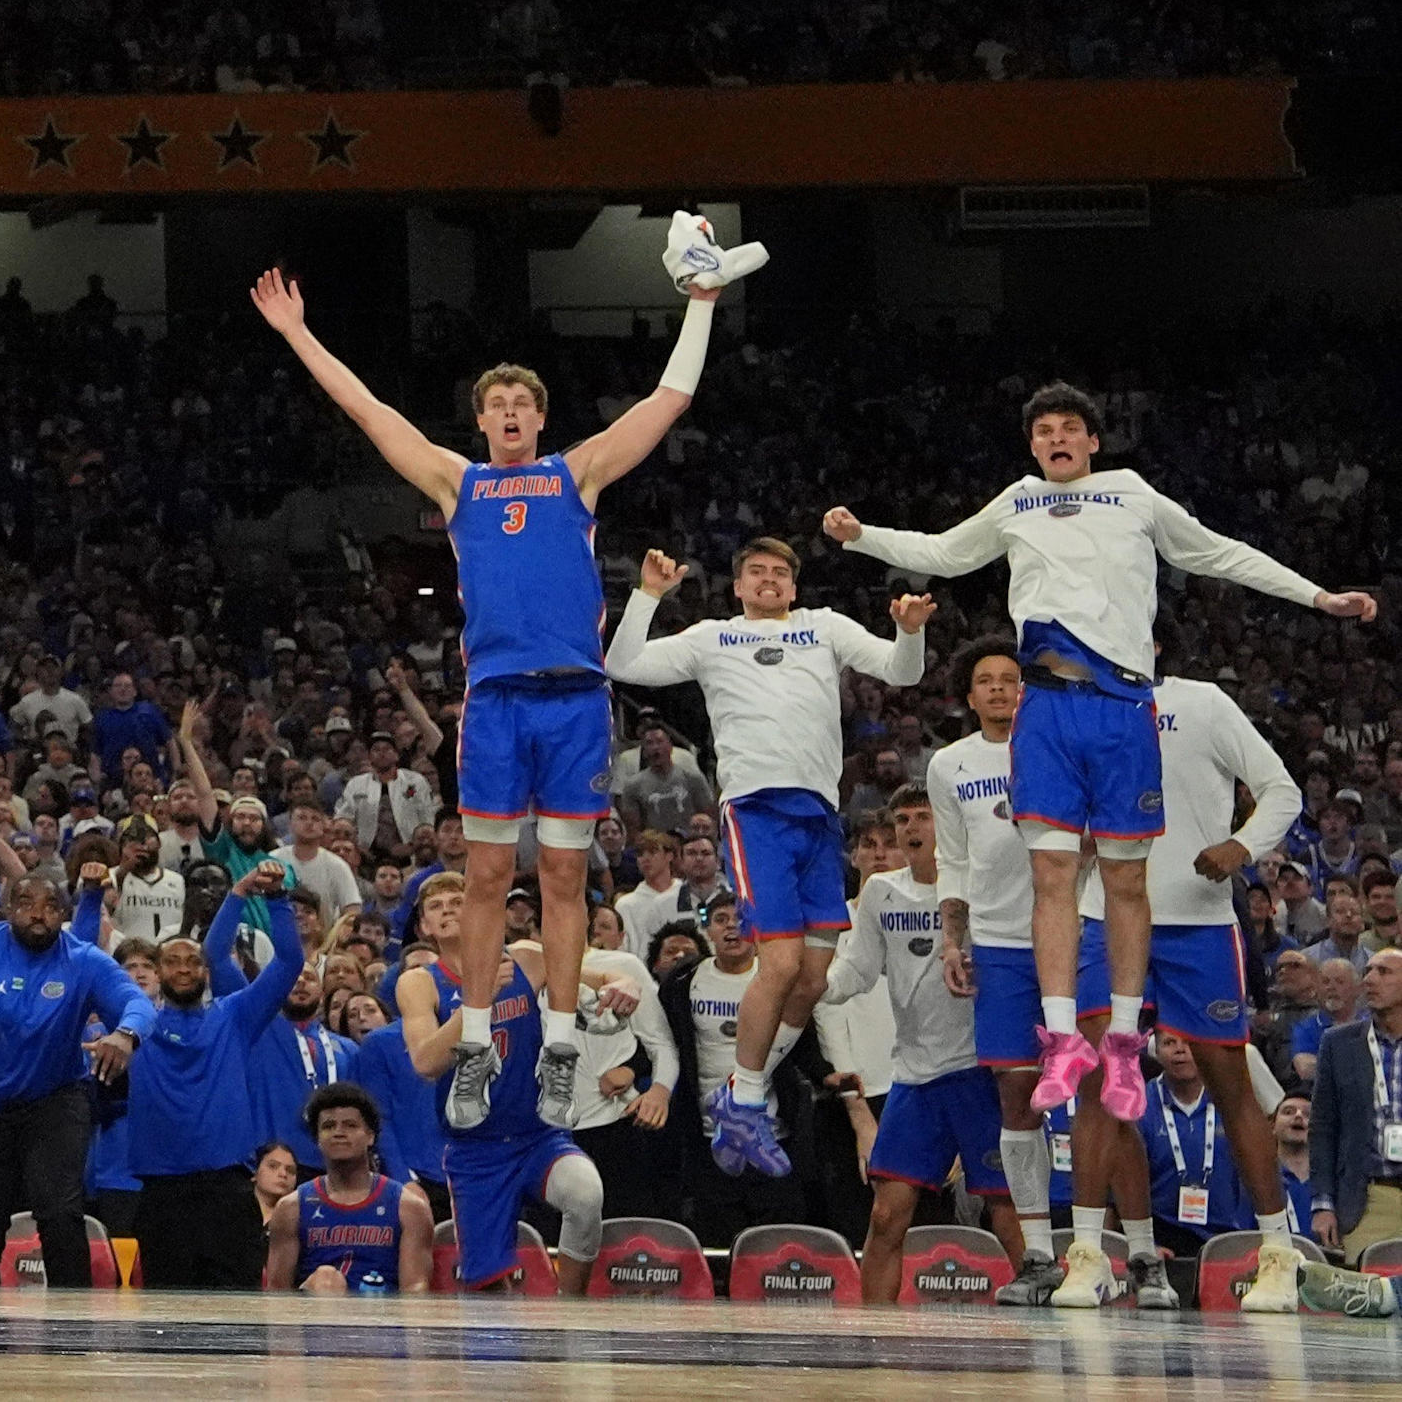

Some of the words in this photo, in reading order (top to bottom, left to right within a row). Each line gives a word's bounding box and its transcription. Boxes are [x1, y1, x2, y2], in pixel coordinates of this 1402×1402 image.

[471, 475, 562, 501] FLORIDA
[501, 501, 528, 535] 3
[1158, 714, 1178, 732] SY.
[956, 776, 1010, 803] NOTHIN
[880, 911, 931, 932] NOTHING
[307, 1225, 394, 1247] FLORIDA
[18, 1259, 45, 1272] FINA
[610, 1266, 644, 1282] FINAL
[645, 1267, 678, 1282] FOUR
[765, 1275, 798, 1290] FINAL
[799, 1276, 832, 1290] FOUR
[918, 1275, 953, 1290] FINAL
[954, 1277, 989, 1290] FOUR
